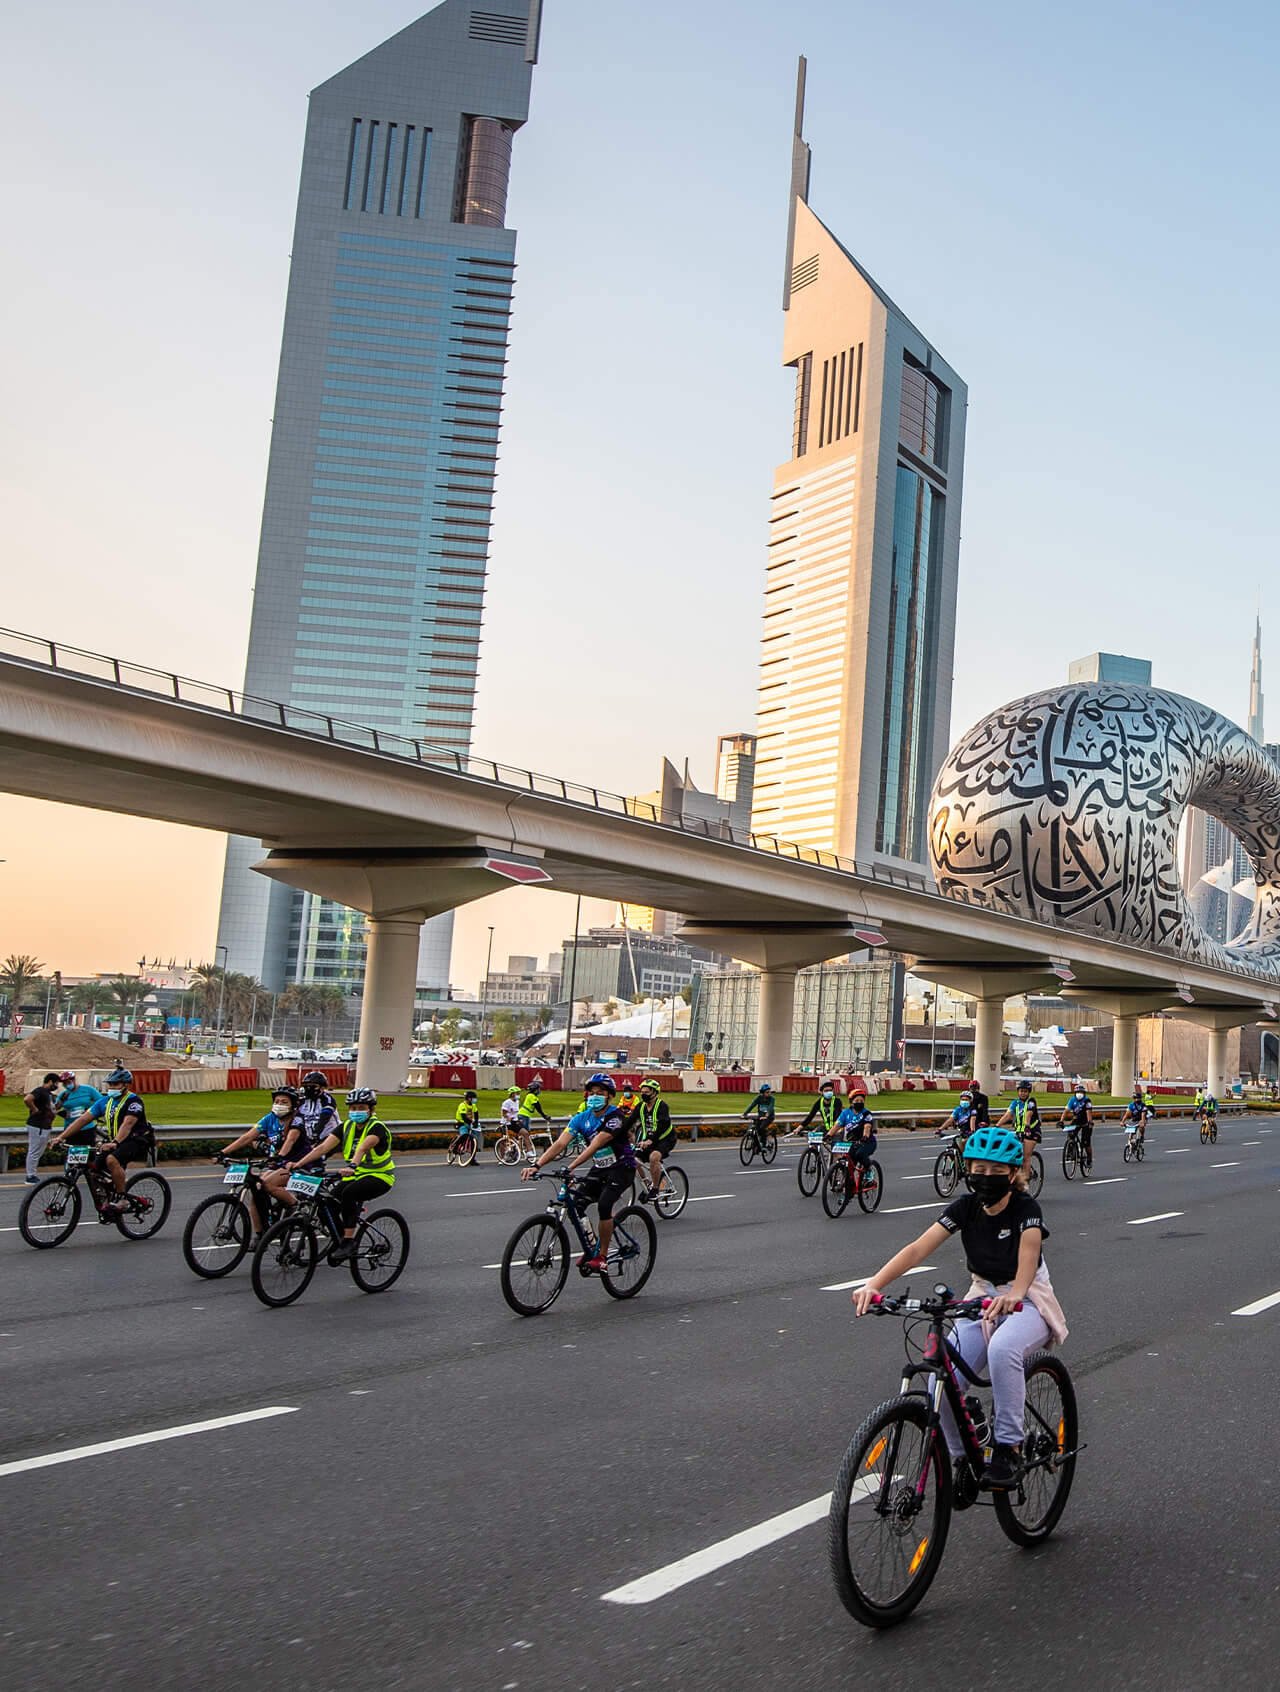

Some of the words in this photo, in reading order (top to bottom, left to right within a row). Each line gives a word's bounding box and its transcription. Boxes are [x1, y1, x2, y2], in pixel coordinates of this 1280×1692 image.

[291, 1181, 316, 1193] 16576
[939, 1216, 957, 1230] NIKE
[1026, 1217, 1041, 1227] NIKE
